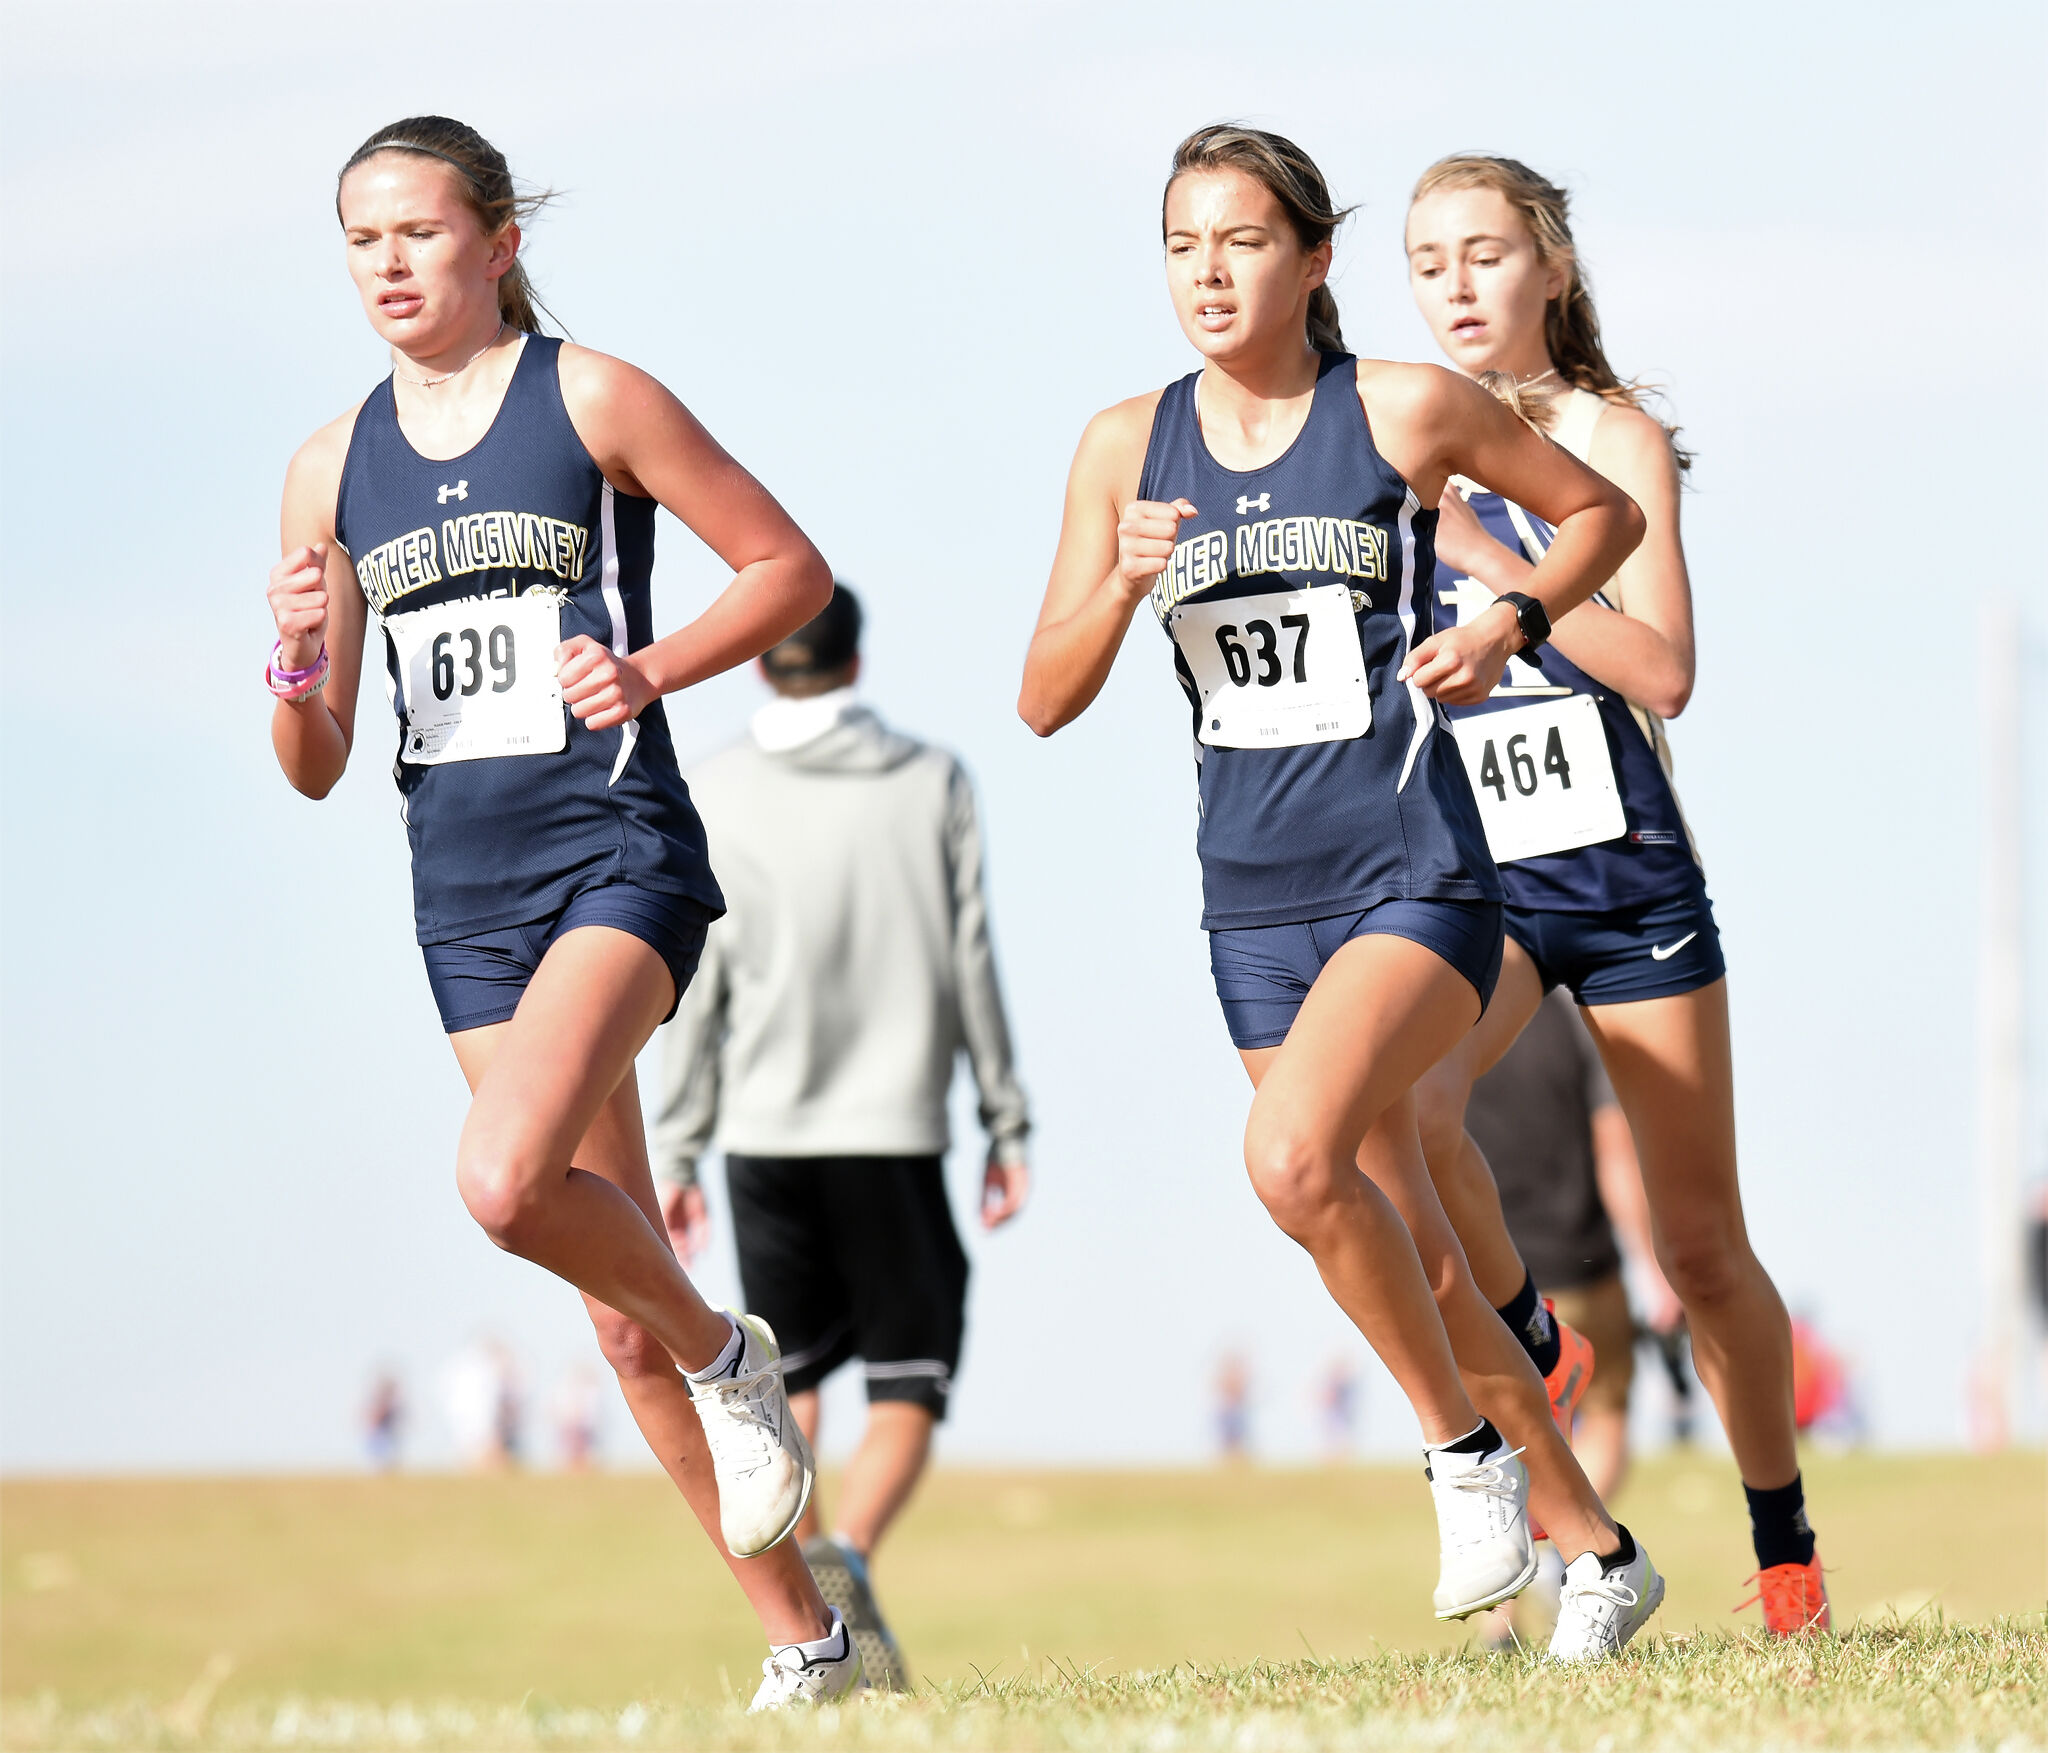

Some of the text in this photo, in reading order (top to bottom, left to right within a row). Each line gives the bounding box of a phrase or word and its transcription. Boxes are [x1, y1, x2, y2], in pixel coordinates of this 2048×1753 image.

[442, 511, 588, 581] MCGIVNEY
[1235, 516, 1388, 582] MCGIVNEY
[431, 624, 517, 701] 639
[1215, 613, 1310, 687] 637
[1480, 726, 1571, 801] 464
